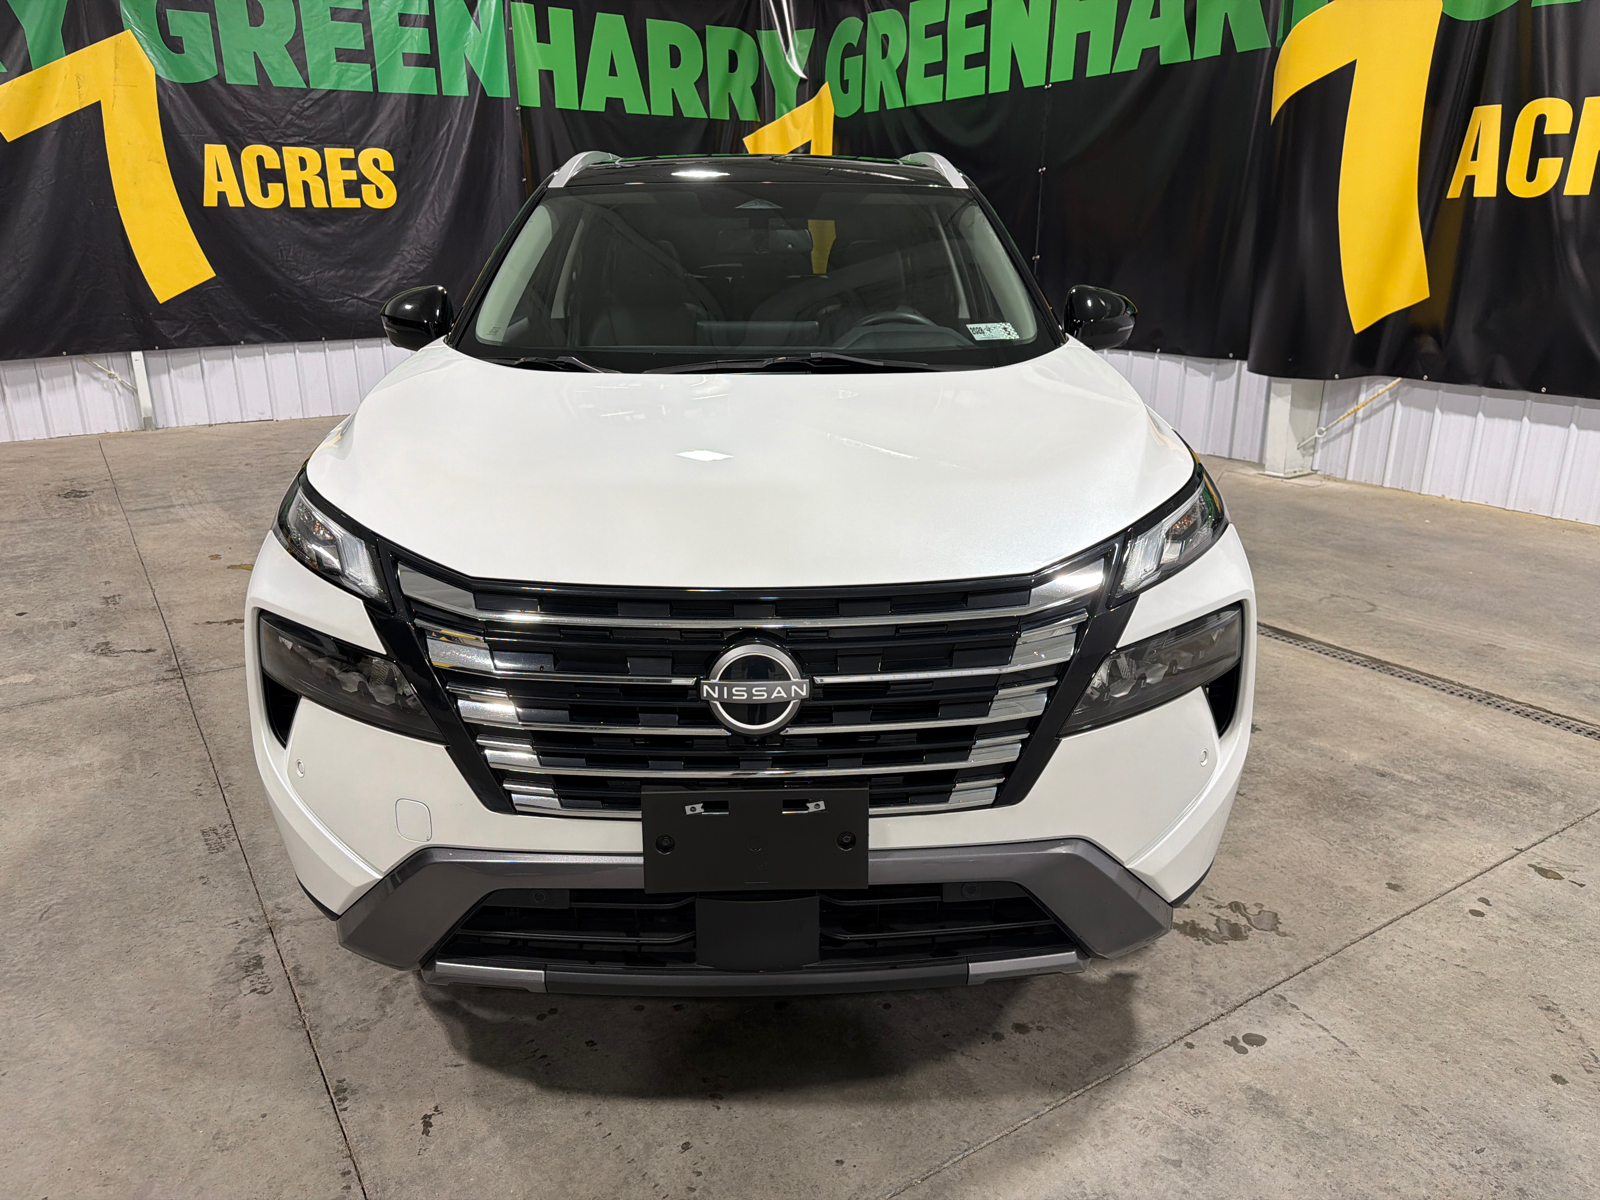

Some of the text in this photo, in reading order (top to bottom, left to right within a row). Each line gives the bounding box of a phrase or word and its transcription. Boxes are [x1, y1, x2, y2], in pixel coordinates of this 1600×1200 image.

[120, 0, 511, 98] GREEN
[511, 0, 1051, 122] HARRY GREEN
[0, 29, 398, 304] 7 ACRES
[1271, 0, 1443, 334] 7
[702, 683, 808, 700] NISSAN
